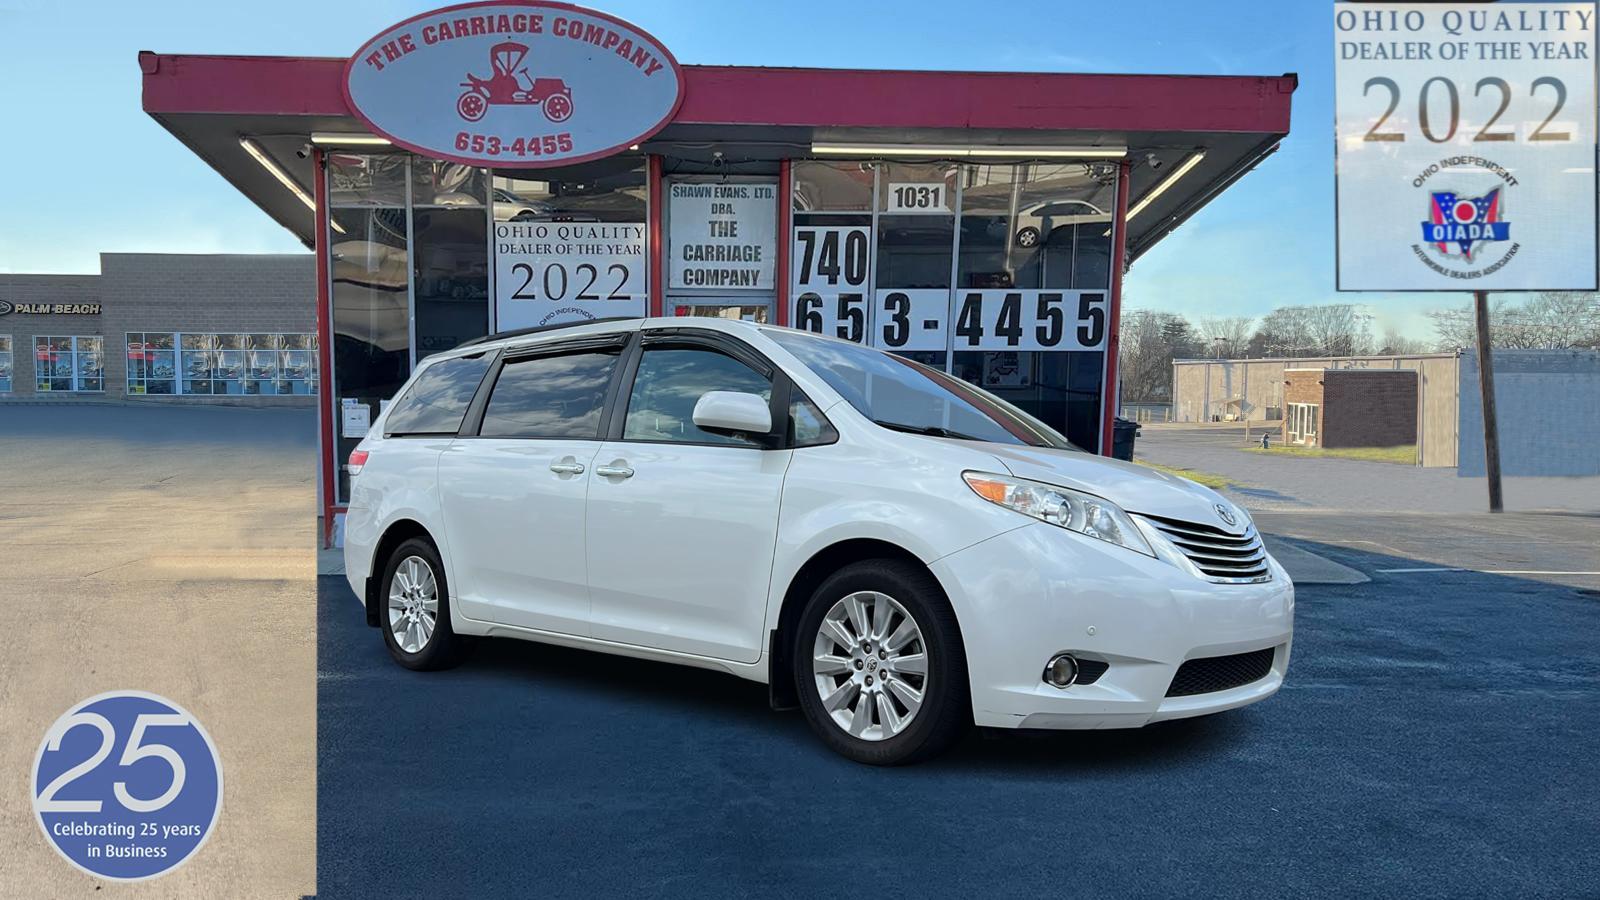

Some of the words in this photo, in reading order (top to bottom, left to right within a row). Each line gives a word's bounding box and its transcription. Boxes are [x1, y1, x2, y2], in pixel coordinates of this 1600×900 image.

[1336, 10, 1426, 31] OHIO
[1441, 10, 1594, 36] QUALITY
[365, 33, 417, 72] THE
[422, 14, 544, 46] CARRIAGE
[552, 17, 664, 77] COMPANY
[1340, 42, 1433, 60] DEALER
[1439, 42, 1469, 60] OF
[1475, 42, 1522, 60] THE
[1528, 42, 1589, 60] YEAR
[1363, 76, 1571, 143] 2022
[454, 131, 573, 157] 653-4455
[1412, 164, 1439, 188] OHIO
[1440, 155, 1519, 187] INDEPENDENT
[672, 186, 712, 198] SHAWN
[754, 186, 774, 198] LTD.
[893, 186, 941, 209] 1031
[711, 203, 736, 215] DBA.
[497, 226, 548, 239] OHIO
[558, 226, 644, 241] QUALITY
[708, 221, 738, 238] THE
[1432, 225, 1495, 240] OIADA
[499, 244, 552, 255] DEALER
[556, 244, 574, 255] OF
[576, 244, 603, 255] THE
[605, 244, 641, 255] YEAR
[683, 245, 762, 262] CARRIAGE
[797, 230, 868, 285] 740
[1410, 243, 1449, 277] AUTOMOBILE
[1449, 269, 1482, 280] DEALERS
[1483, 242, 1521, 276] ASSOCIATION
[511, 263, 631, 301] 2022
[683, 269, 760, 286] COMPANY
[15, 304, 50, 314] PALM
[54, 304, 100, 314] BEACH
[539, 312, 556, 326] OHIO
